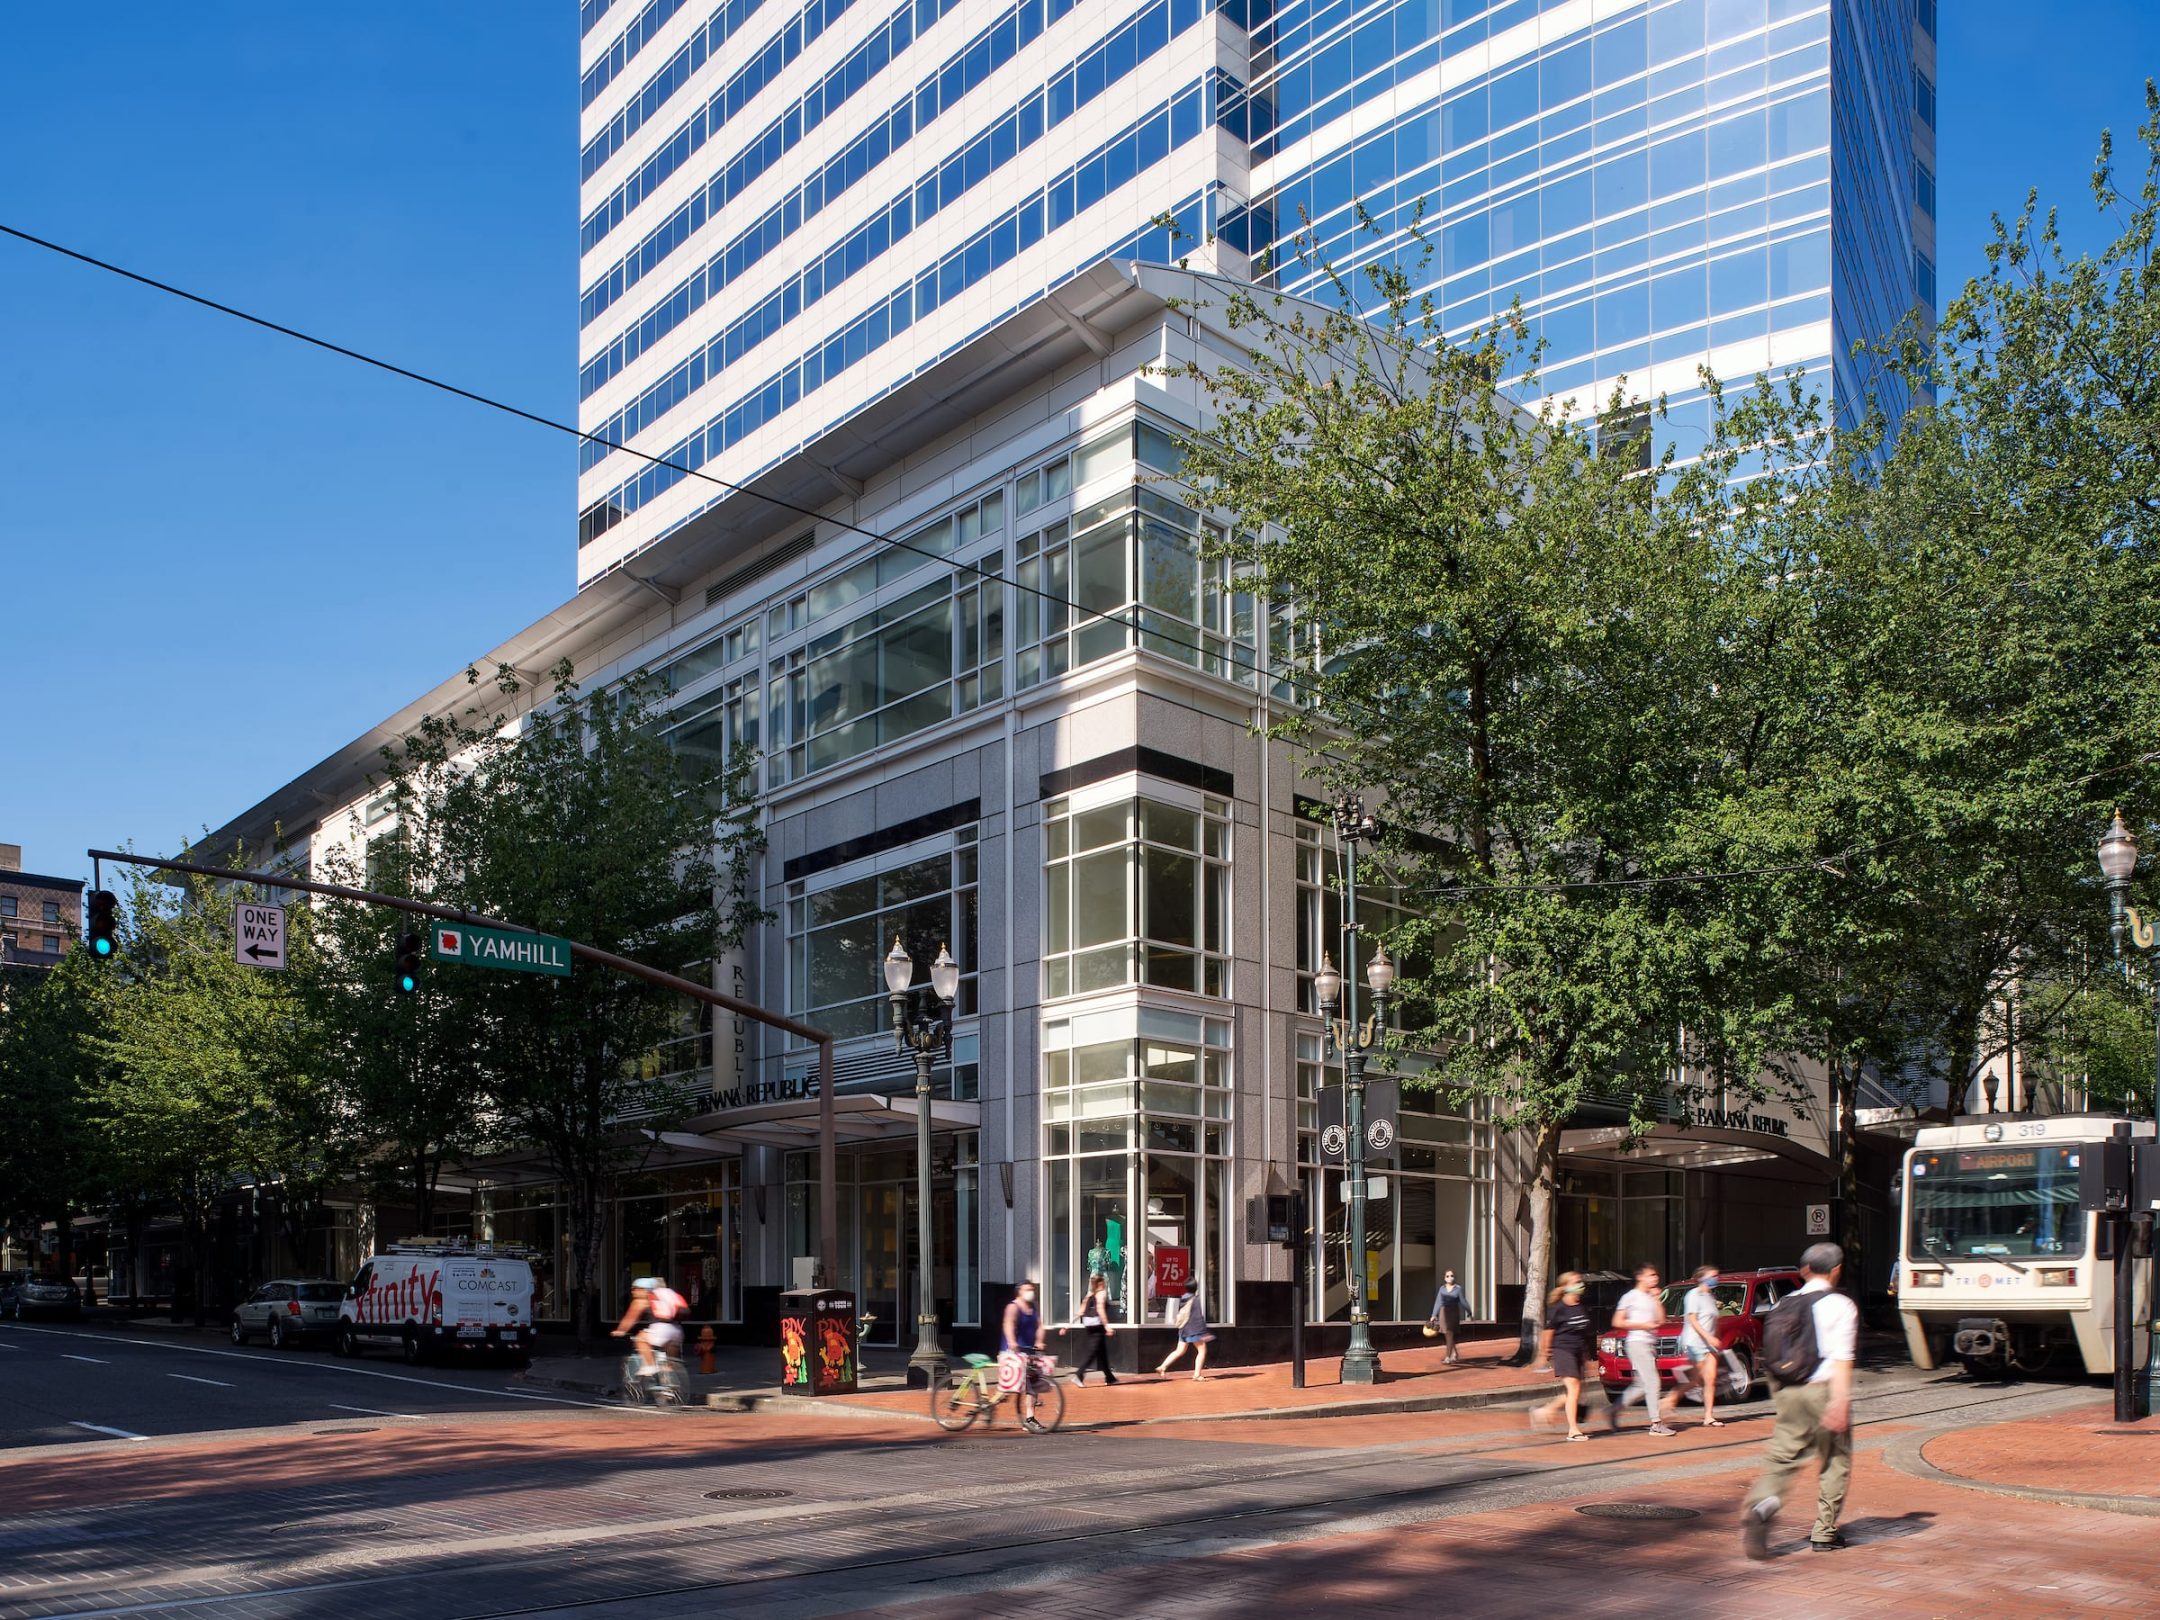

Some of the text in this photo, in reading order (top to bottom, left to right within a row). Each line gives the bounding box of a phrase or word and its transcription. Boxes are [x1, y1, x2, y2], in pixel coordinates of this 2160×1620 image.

[245, 909, 277, 926] ONE
[243, 925, 278, 942] WAY
[468, 934, 565, 967] YAMHILL
[732, 965, 746, 1107] REUBLIC
[746, 1075, 820, 1104] REPUBLIC
[1697, 1107, 1750, 1130] BANANA
[2018, 1123, 2046, 1137] 319
[1976, 1153, 2034, 1169] AIRPORT
[458, 1280, 518, 1292] COMCAST
[1995, 1276, 2021, 1285] MET
[355, 1263, 440, 1325] xfinity
[781, 1317, 807, 1340] PDX
[816, 1317, 852, 1341] PDX
